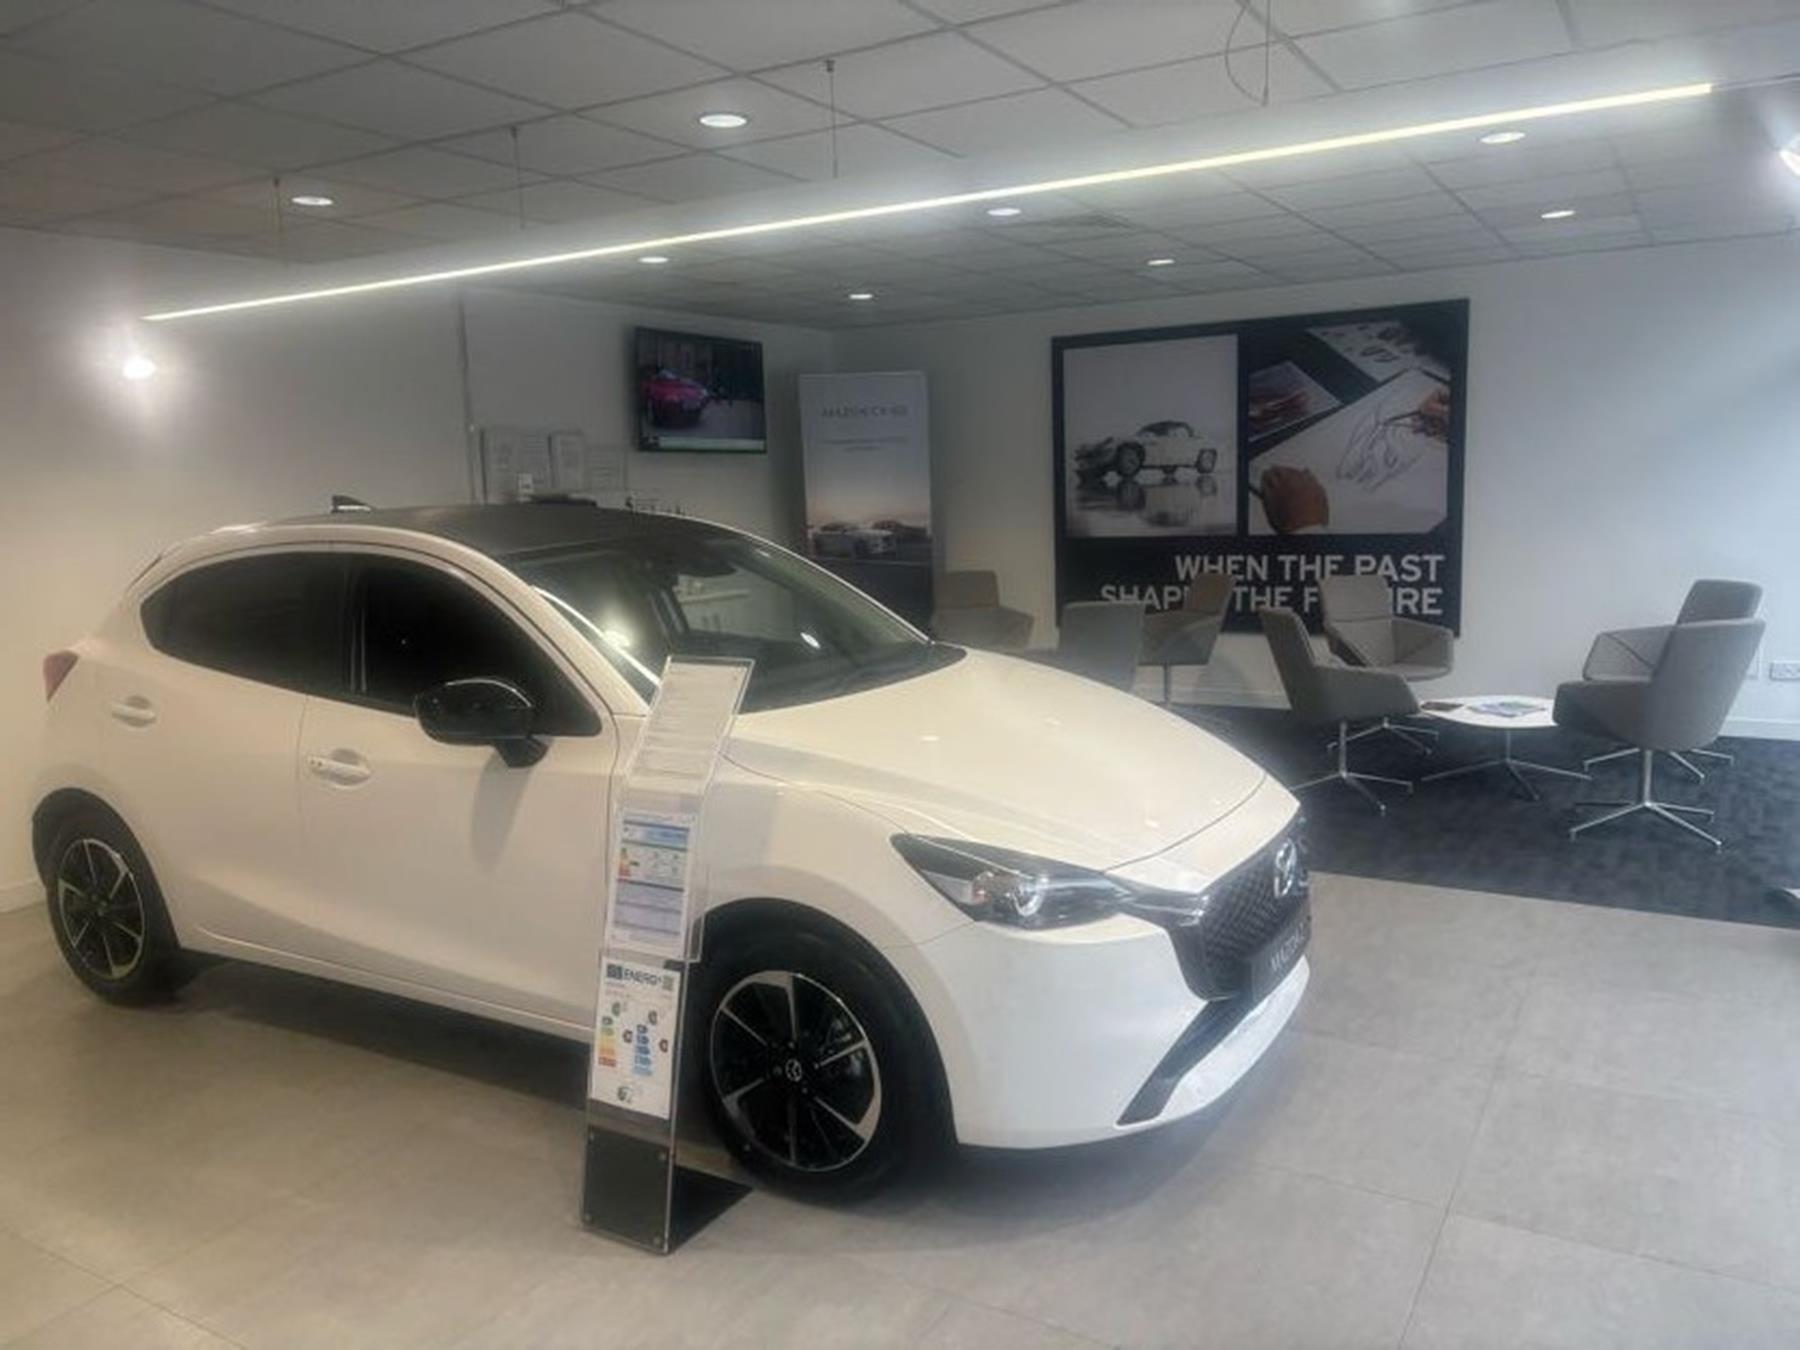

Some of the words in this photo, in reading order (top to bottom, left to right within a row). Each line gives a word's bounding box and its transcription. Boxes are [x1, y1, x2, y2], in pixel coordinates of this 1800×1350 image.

[1175, 554, 1269, 581] WHEN
[1277, 554, 1344, 580] THE
[1354, 553, 1445, 582] PAST
[1232, 586, 1294, 613] THE
[1303, 587, 1445, 615] FRE
